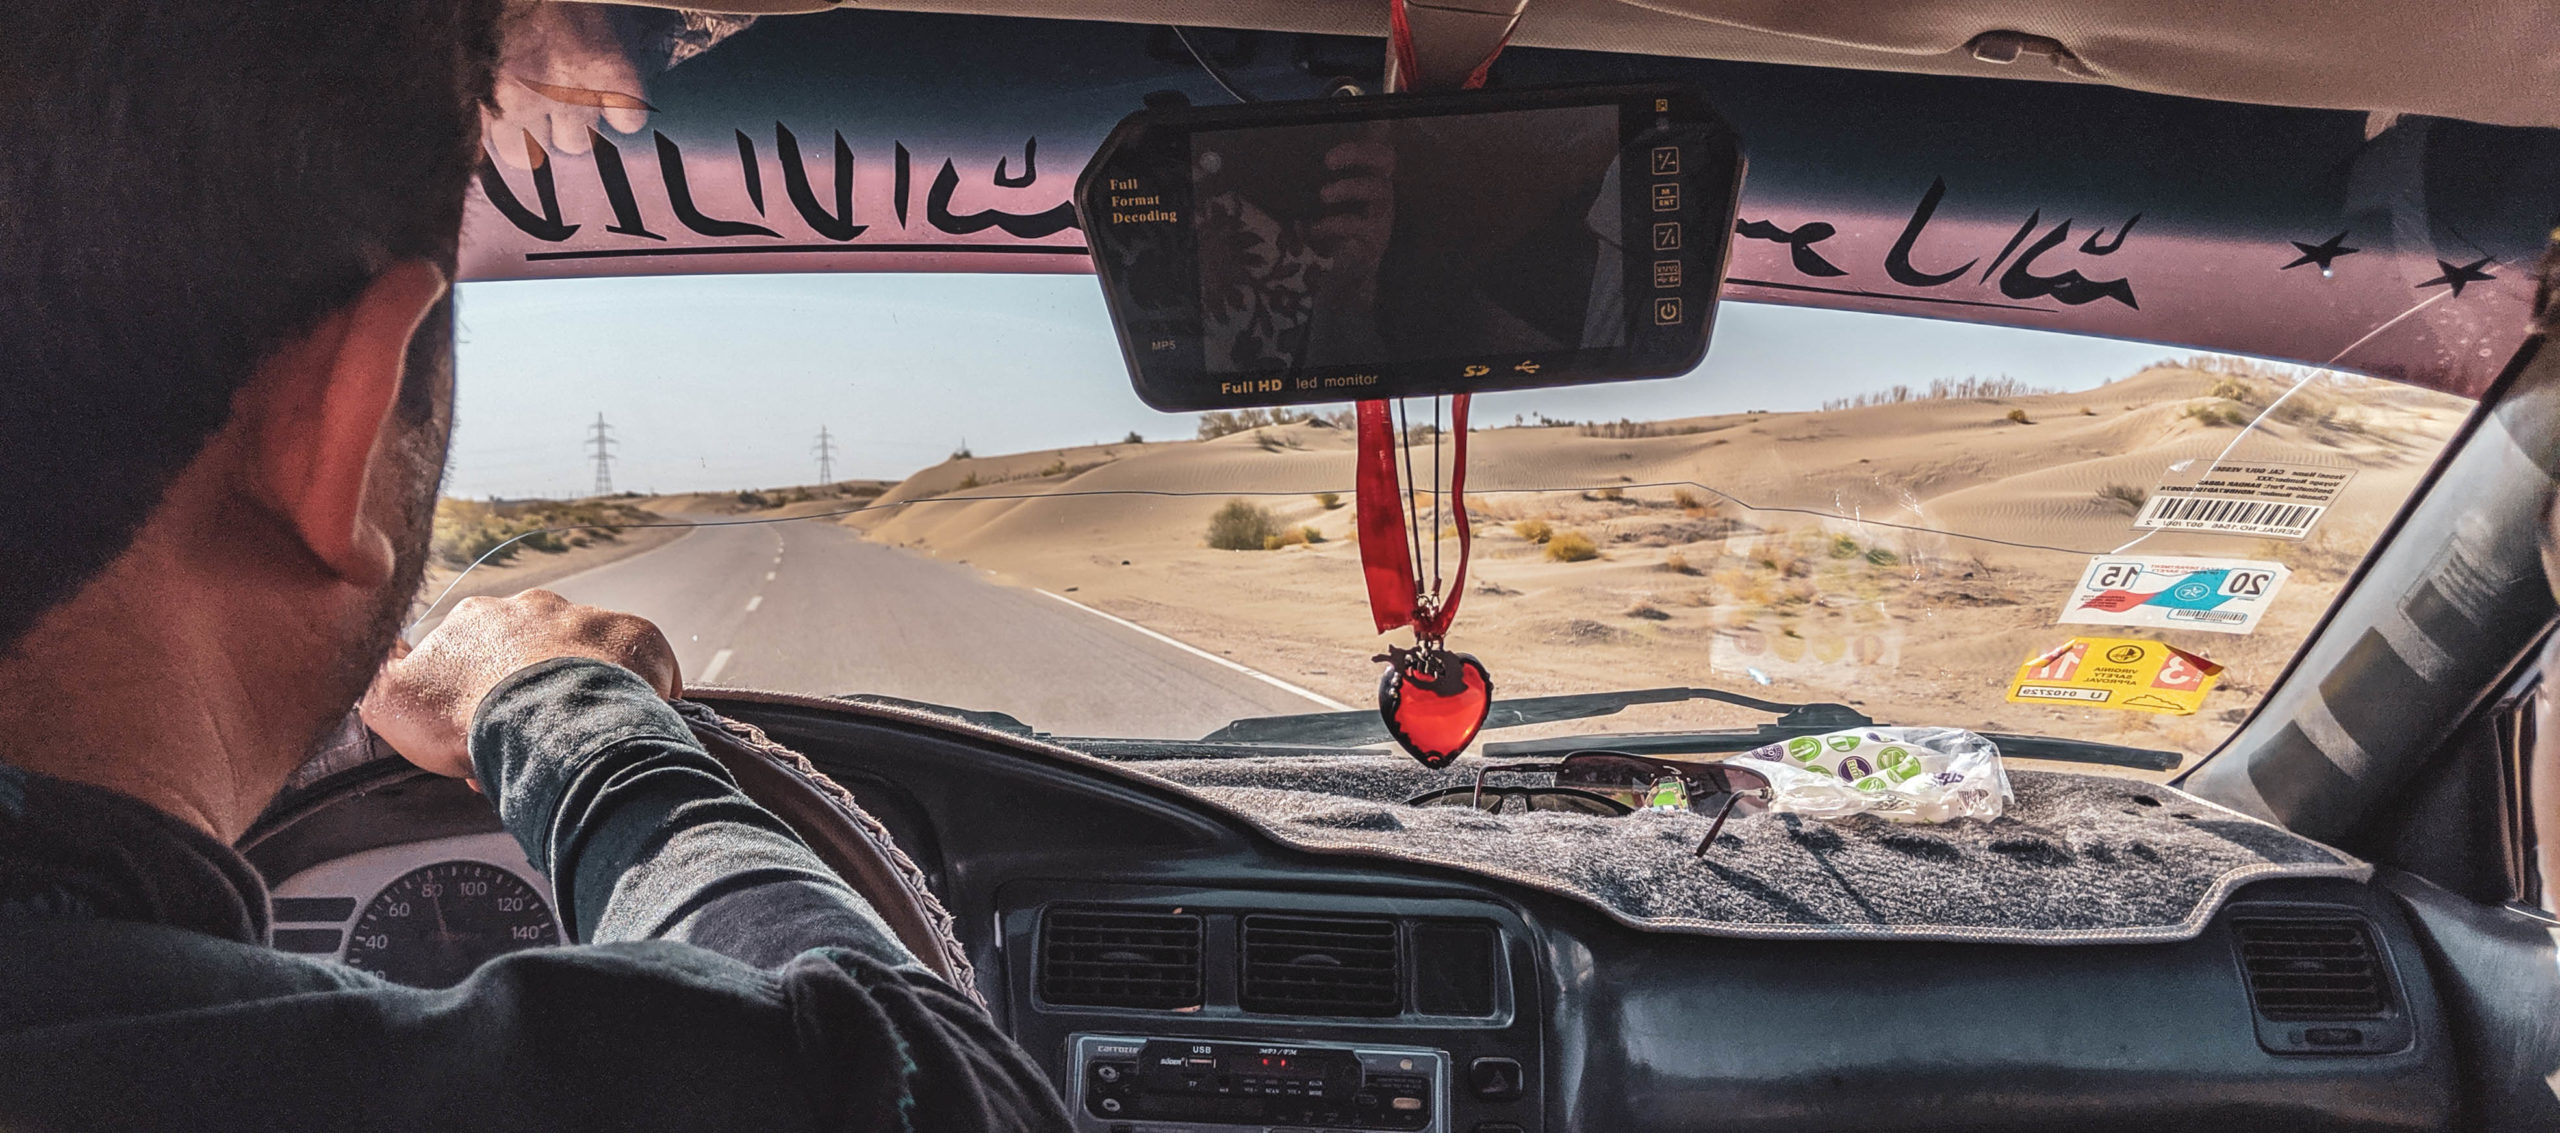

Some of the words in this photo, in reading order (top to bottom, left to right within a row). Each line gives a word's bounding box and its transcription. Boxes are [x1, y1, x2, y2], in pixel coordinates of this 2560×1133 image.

[1110, 179, 1138, 190] Full
[1111, 195, 1160, 207] Format
[1113, 210, 1178, 223] Decoding
[1152, 341, 1176, 351] MP5
[1221, 380, 1253, 395] Full
[1258, 378, 1282, 392] HD
[1296, 376, 1317, 390] led
[1324, 374, 1378, 389] monitor
[459, 882, 488, 897] 100
[388, 902, 411, 918] 60
[497, 898, 523, 913] 120
[511, 925, 539, 941] 140
[365, 934, 389, 950] 40
[1192, 1045, 1212, 1054] USB
